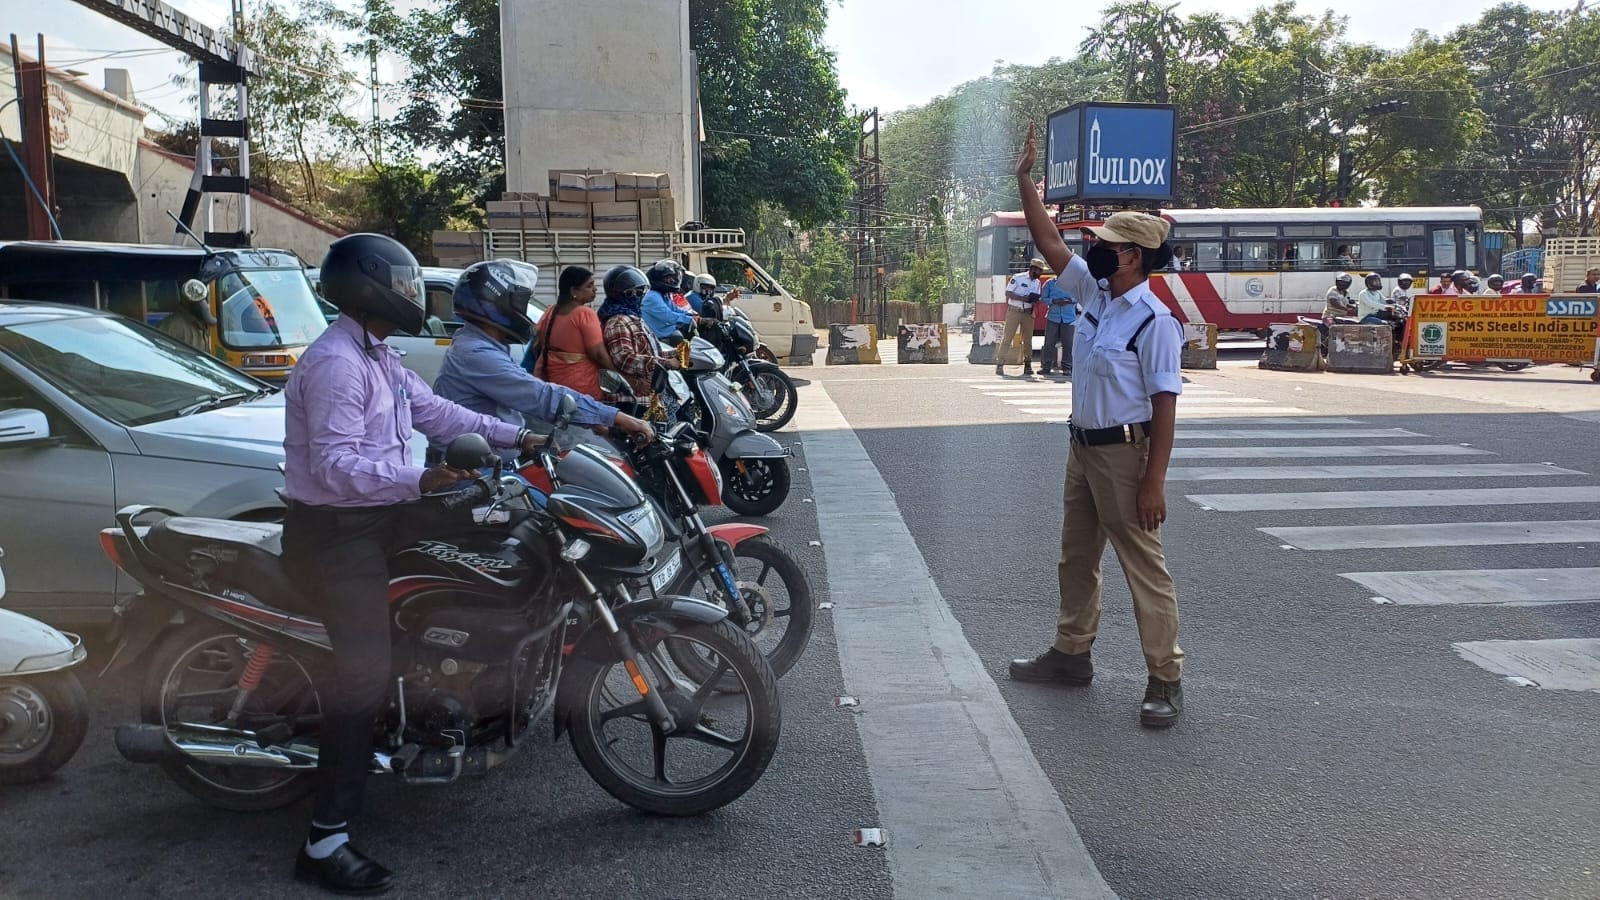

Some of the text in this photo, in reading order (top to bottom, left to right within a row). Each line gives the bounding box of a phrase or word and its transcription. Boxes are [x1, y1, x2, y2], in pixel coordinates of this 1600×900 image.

[1088, 112, 1167, 185] BUILDOX
[1418, 299, 1537, 313] VIZAG UKKU
[1546, 300, 1597, 316] SSMS
[1449, 320, 1598, 333] SSMS Steels India LLP
[1448, 348, 1512, 358] CHILKALGUDA
[1515, 350, 1556, 359] TRAFFIC
[1560, 350, 1595, 360] POLICE
